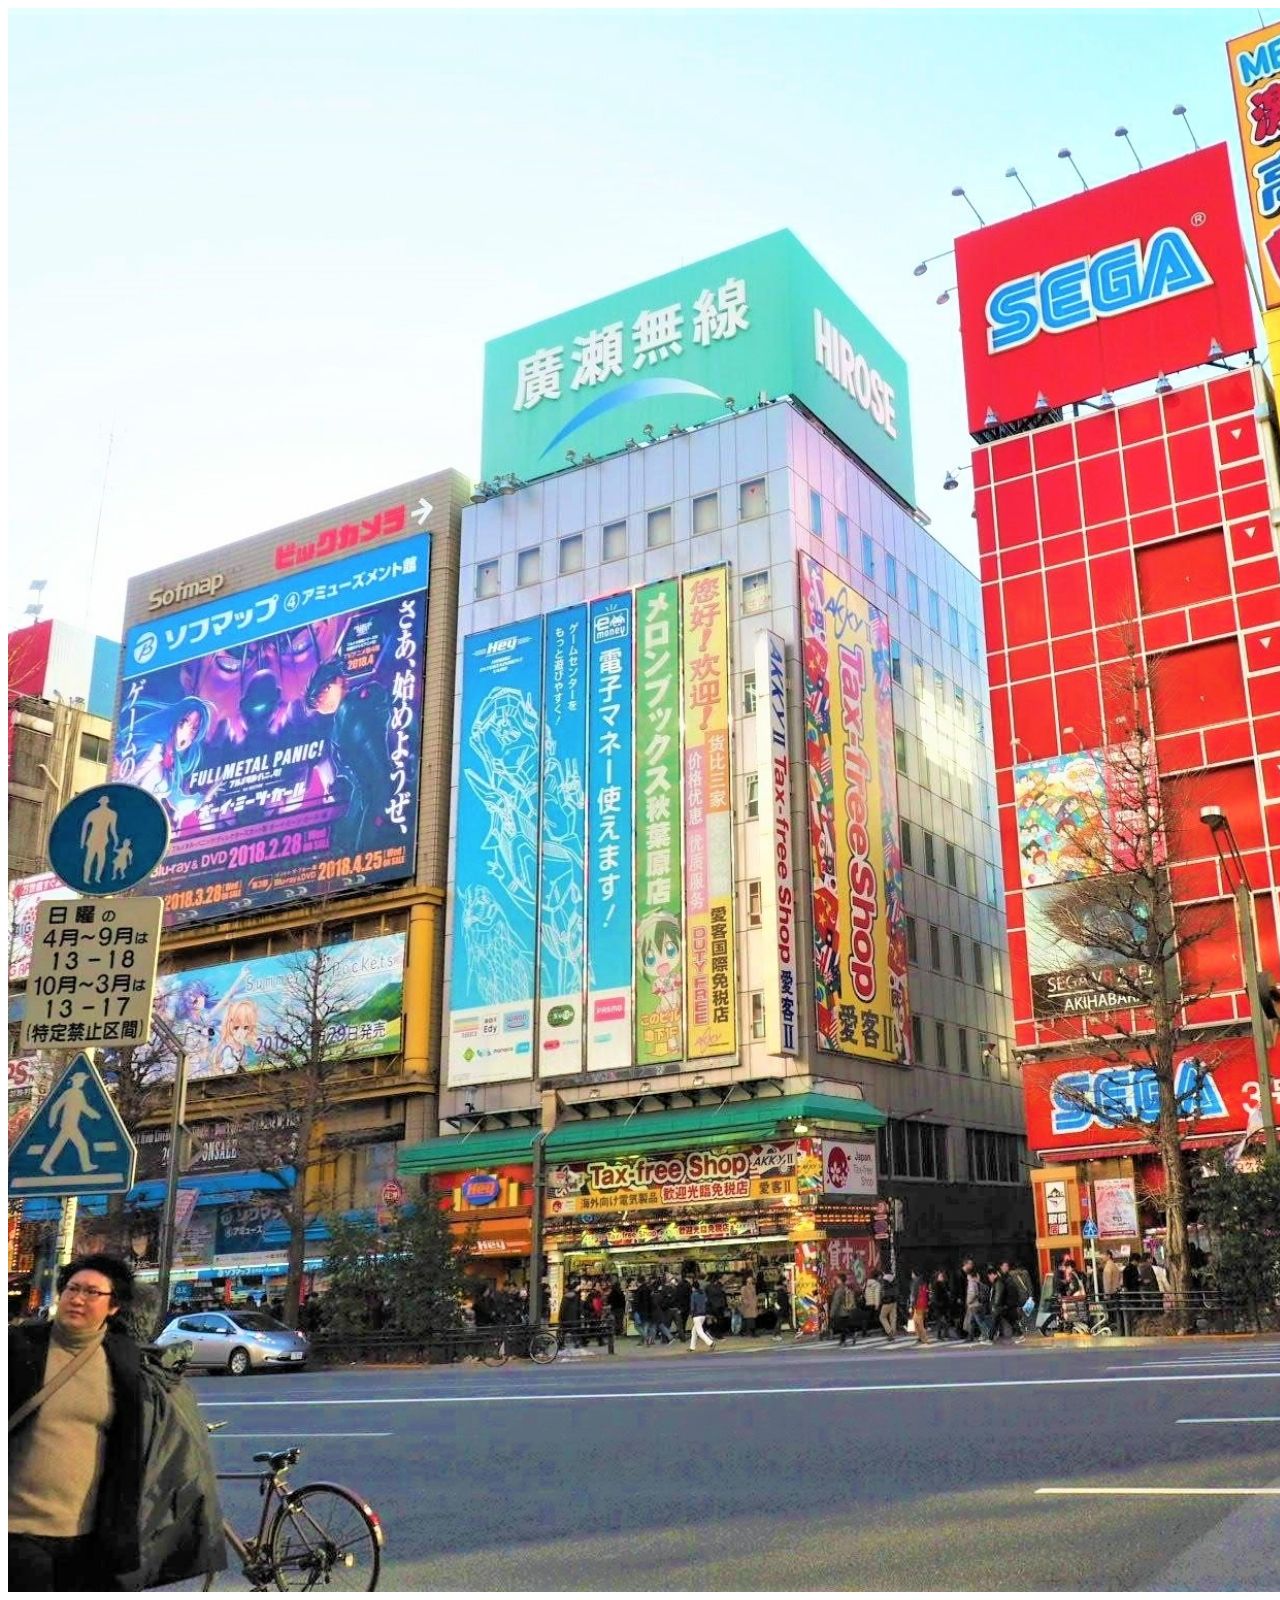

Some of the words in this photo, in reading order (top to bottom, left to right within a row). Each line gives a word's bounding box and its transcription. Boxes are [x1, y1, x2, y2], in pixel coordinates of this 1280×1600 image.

[985, 226, 1215, 355] SEGA
[513, 277, 750, 412] 廣瀬無線
[814, 307, 897, 440] HIROSE
[274, 504, 407, 571] ビックカメラ
[148, 572, 225, 611] Sofmap
[164, 593, 281, 652] ソフマップ
[486, 635, 518, 655] Hey
[567, 621, 579, 712] ゲームセンターを
[118, 679, 146, 779] ゲームの
[384, 599, 418, 835] さあ、始めようぜ、
[190, 756, 271, 788] FULLMETAL
[272, 739, 325, 767] PANIC!
[643, 591, 672, 906] メロンブックス秋葉原店
[709, 733, 728, 809] 货比三家
[838, 644, 872, 861] Tax-free
[773, 755, 789, 880] Tax-free
[200, 853, 228, 869] DVD
[227, 832, 301, 869] 2018.2.28
[318, 849, 383, 882] 2018.4.25
[164, 883, 222, 912] 2018.3.28
[692, 926, 708, 974] DUTY
[777, 887, 793, 965] Shop
[849, 860, 877, 1001] Shop
[711, 905, 729, 1024] 愛客国際免税店
[693, 976, 709, 1025] FREE
[27, 1019, 144, 1043] (特定禁止区間)
[483, 1024, 498, 1036] Edy
[590, 1157, 684, 1188] Tax-free
[688, 1152, 748, 1181] Shop
[854, 1152, 872, 1164] Japan
[581, 1191, 659, 1211] 海外向け電気製品
[661, 1180, 750, 1204] 歓迎光臨免税店
[476, 1240, 507, 1251] Hey
